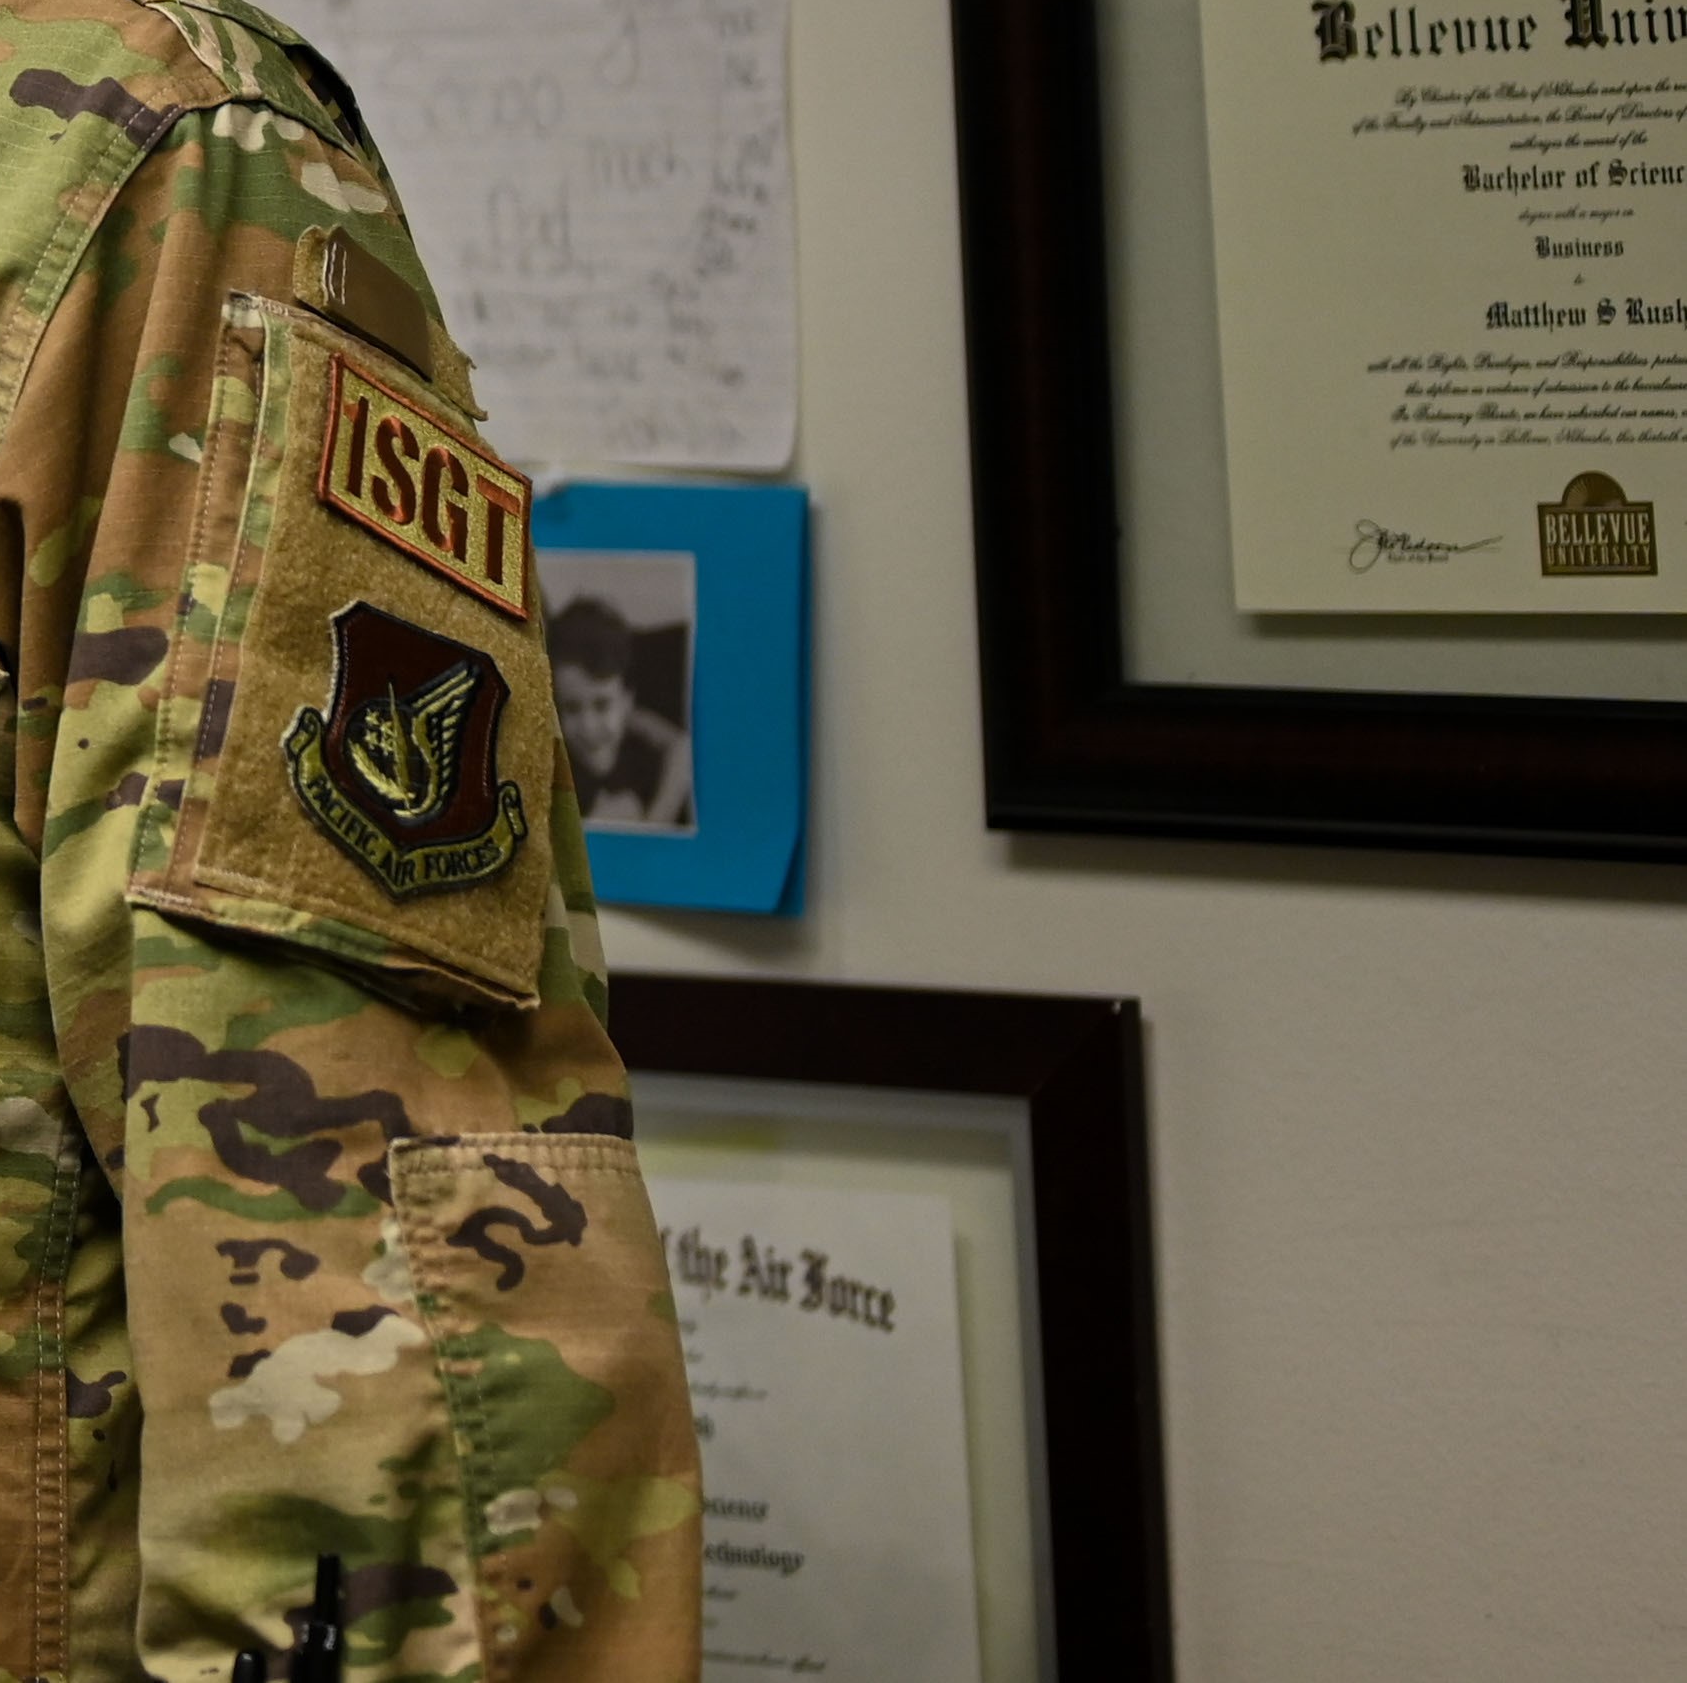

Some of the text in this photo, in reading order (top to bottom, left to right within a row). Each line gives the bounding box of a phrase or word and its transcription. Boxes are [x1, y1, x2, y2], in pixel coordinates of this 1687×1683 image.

[1462, 163, 1566, 196] Bachelor
[1575, 161, 1601, 189] of
[1534, 235, 1624, 259] Business
[1486, 297, 1687, 333] Matthew S Rush
[343, 395, 522, 586] 1SGT
[1544, 511, 1651, 545] BELLEVUE
[1545, 544, 1652, 567] UNIVERSITY
[307, 776, 503, 887] PACIFIC AIR FORCES
[677, 1227, 730, 1303] the
[737, 1233, 793, 1306] Air
[798, 1248, 899, 1334] Force
[702, 1542, 806, 1577] echnology
